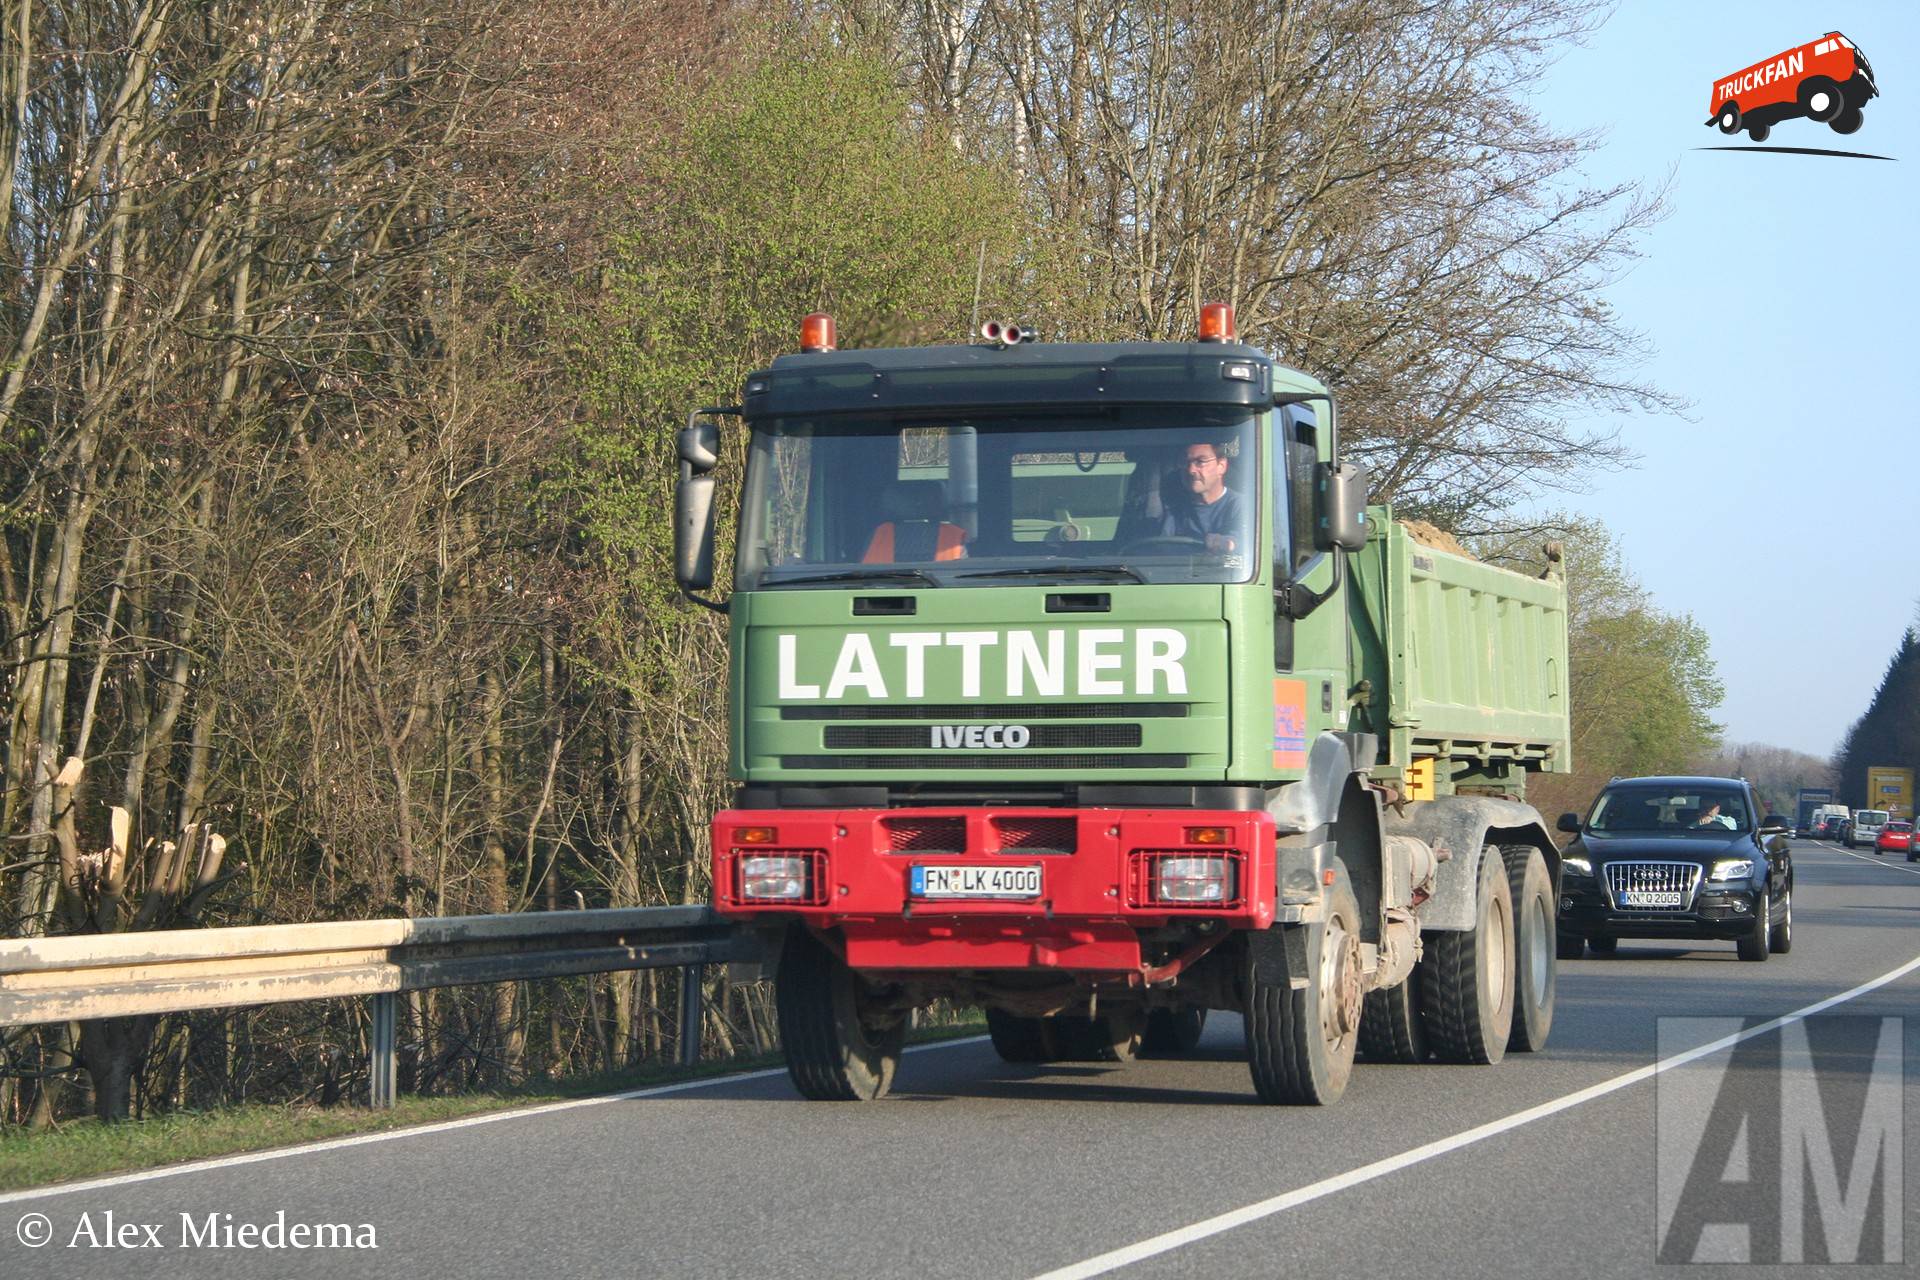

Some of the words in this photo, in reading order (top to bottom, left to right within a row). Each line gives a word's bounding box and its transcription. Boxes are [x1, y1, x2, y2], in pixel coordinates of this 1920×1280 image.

[778, 628, 1188, 699] LATTNER
[931, 725, 1031, 749] IVECO
[926, 870, 949, 890] FN
[964, 870, 986, 890] LK
[992, 870, 1037, 891] 4000
[1655, 893, 1680, 904] 2005
